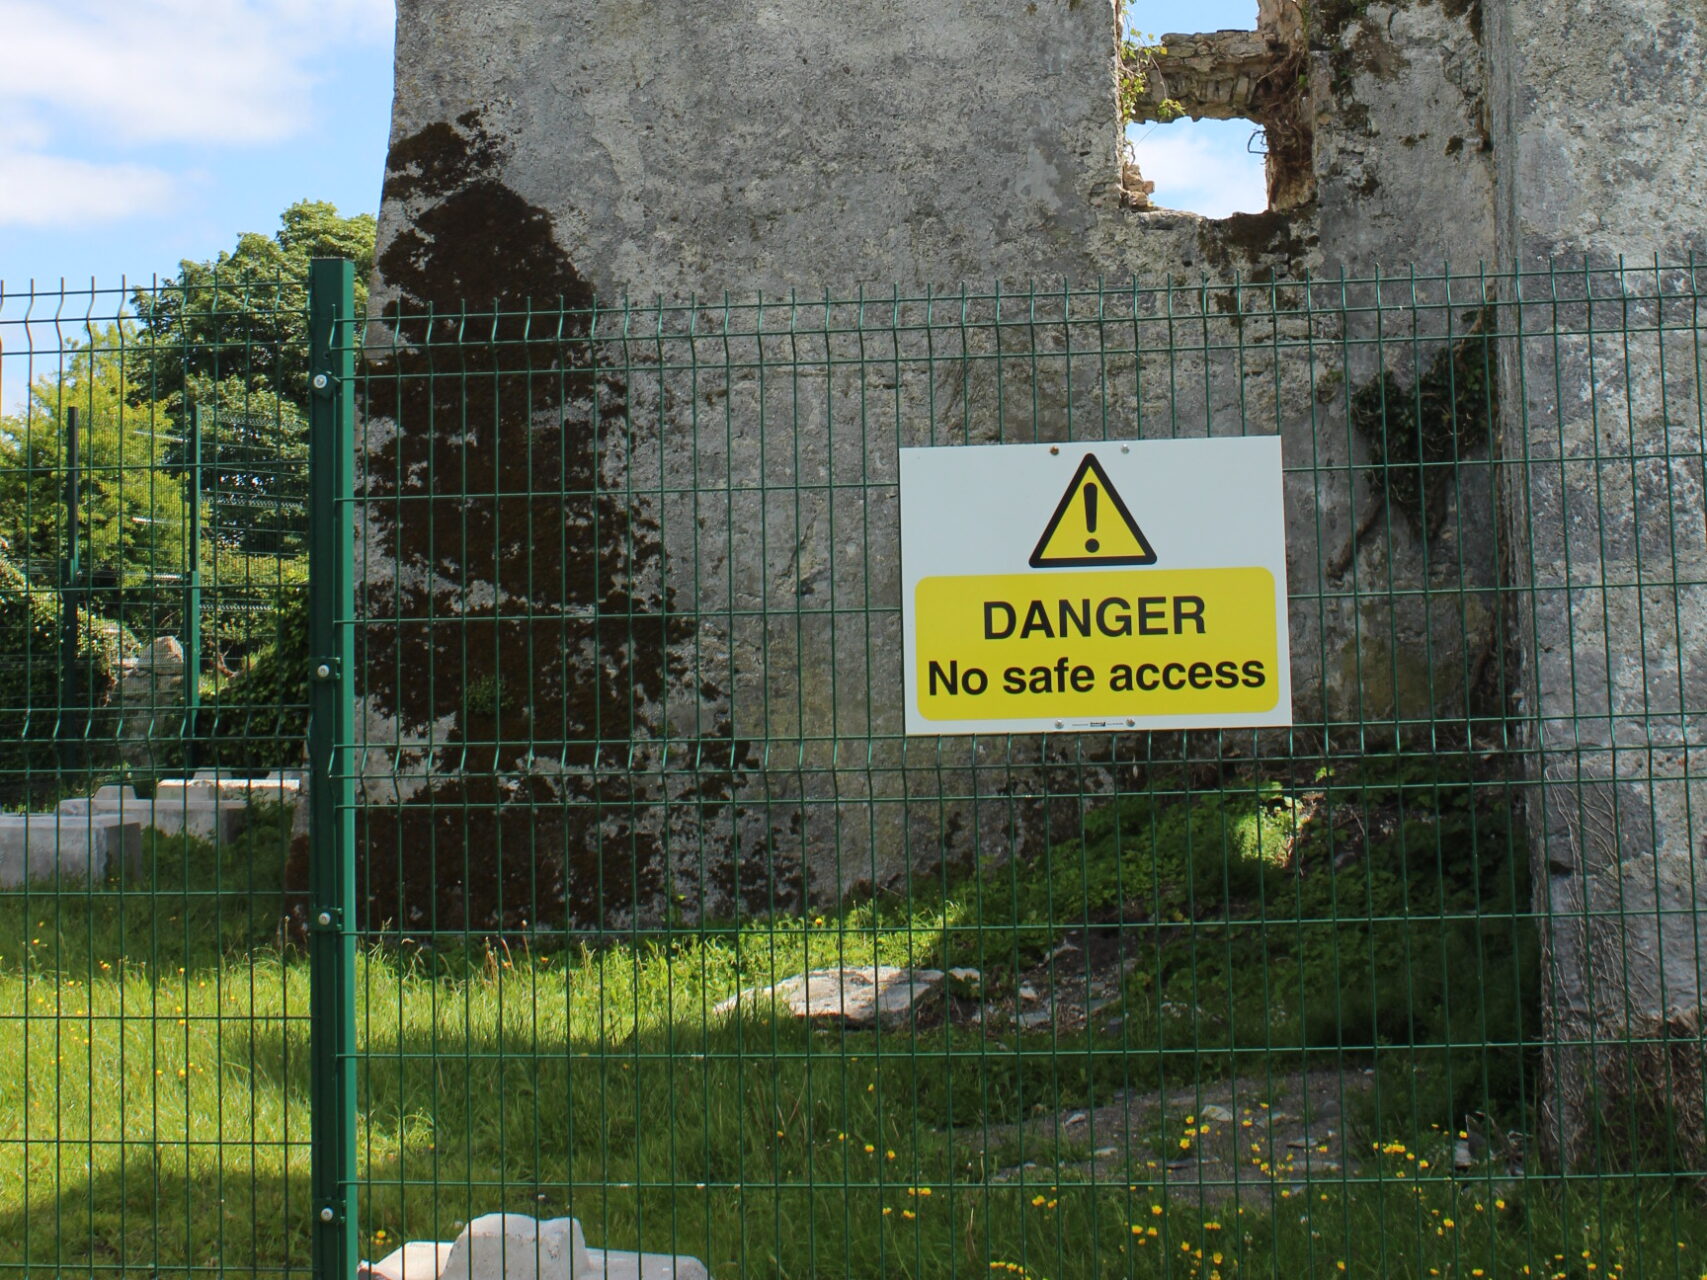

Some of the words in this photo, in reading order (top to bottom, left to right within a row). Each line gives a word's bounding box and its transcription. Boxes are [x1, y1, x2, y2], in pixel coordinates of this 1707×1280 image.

[983, 595, 1206, 640] DANGER
[928, 660, 989, 696] No
[1002, 656, 1095, 695] safe
[1109, 660, 1266, 692] access
